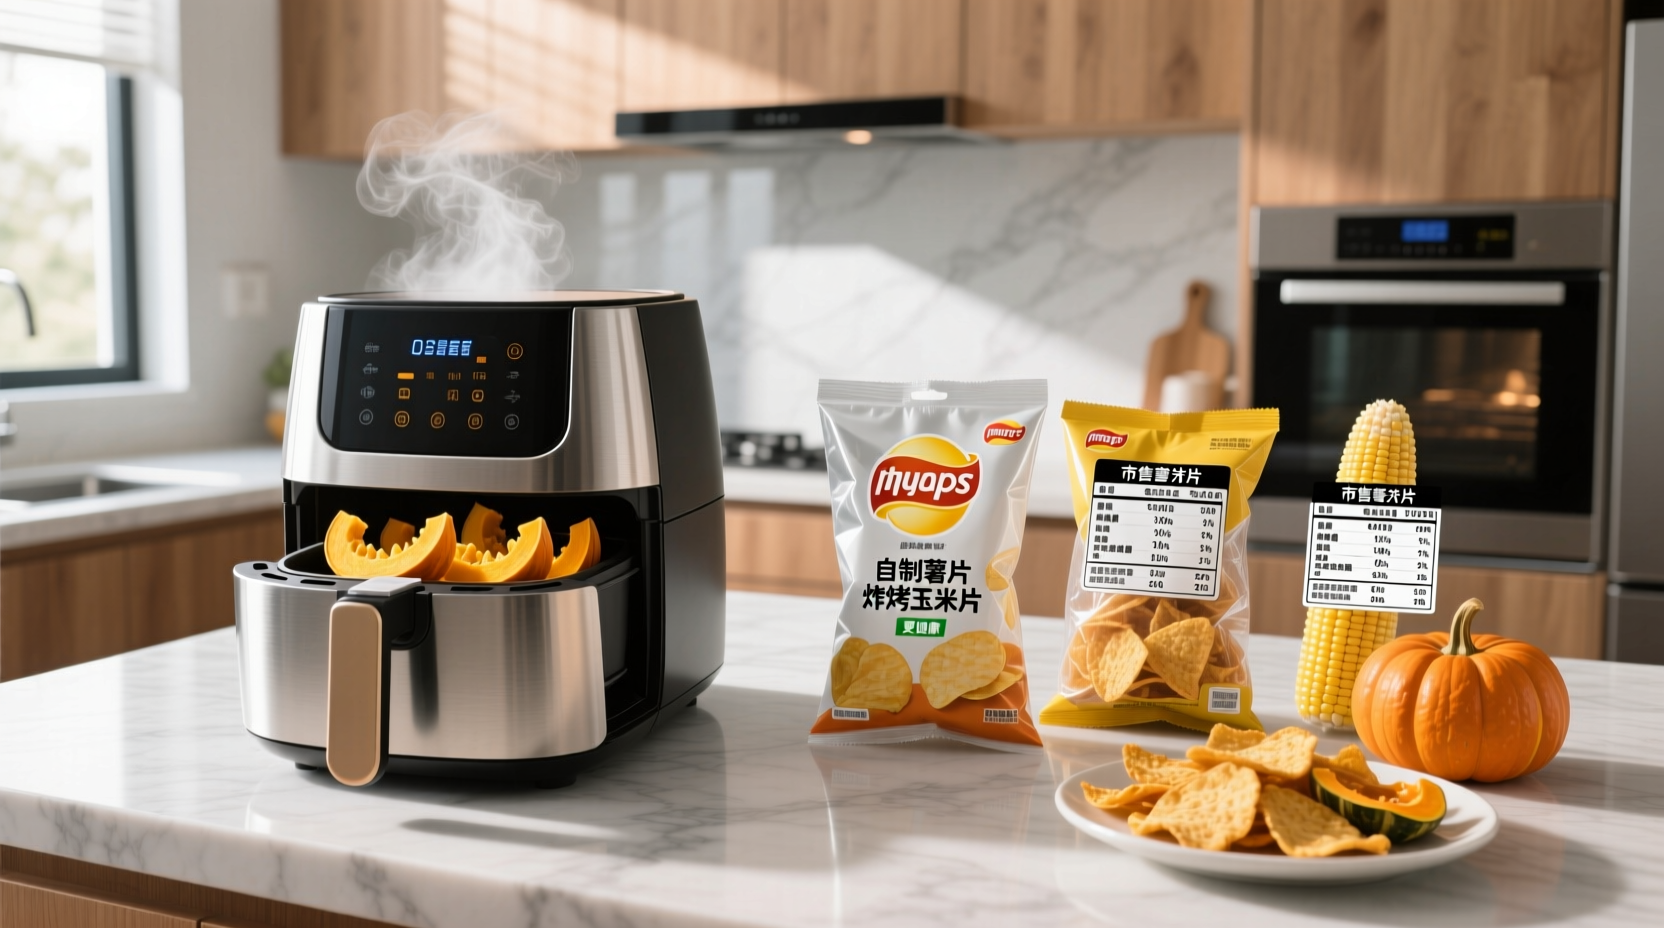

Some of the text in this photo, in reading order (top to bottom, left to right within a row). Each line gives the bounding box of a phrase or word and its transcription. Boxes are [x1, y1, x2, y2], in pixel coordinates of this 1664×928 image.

[877, 557, 971, 585] 自制薯片
[862, 583, 982, 613] 炸烤玉米片
